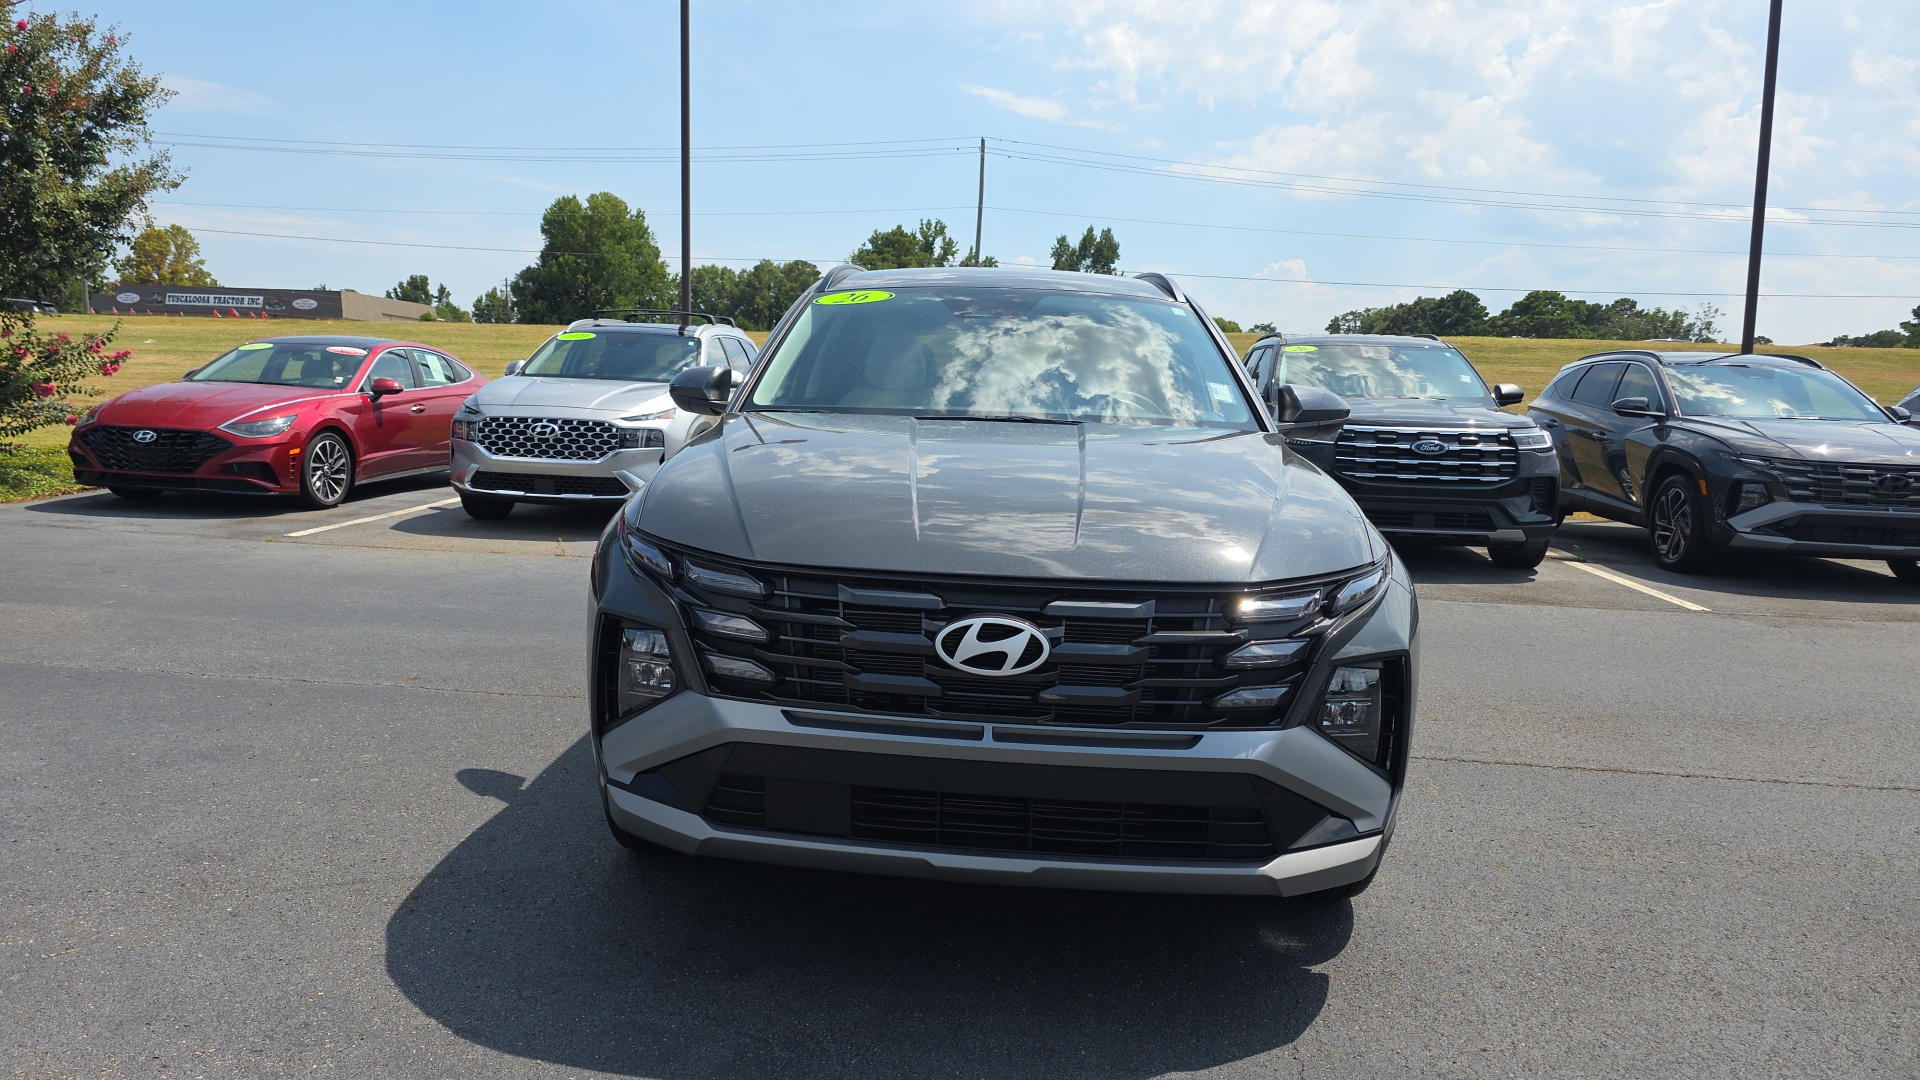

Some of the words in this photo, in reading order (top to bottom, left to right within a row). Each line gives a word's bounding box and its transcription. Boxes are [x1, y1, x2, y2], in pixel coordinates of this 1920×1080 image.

[167, 294, 210, 304] TUSCALOOSA
[213, 296, 245, 305] TRACTOR
[247, 297, 262, 306] INC.
[832, 292, 873, 303] 26
[1420, 443, 1441, 452] Ford
